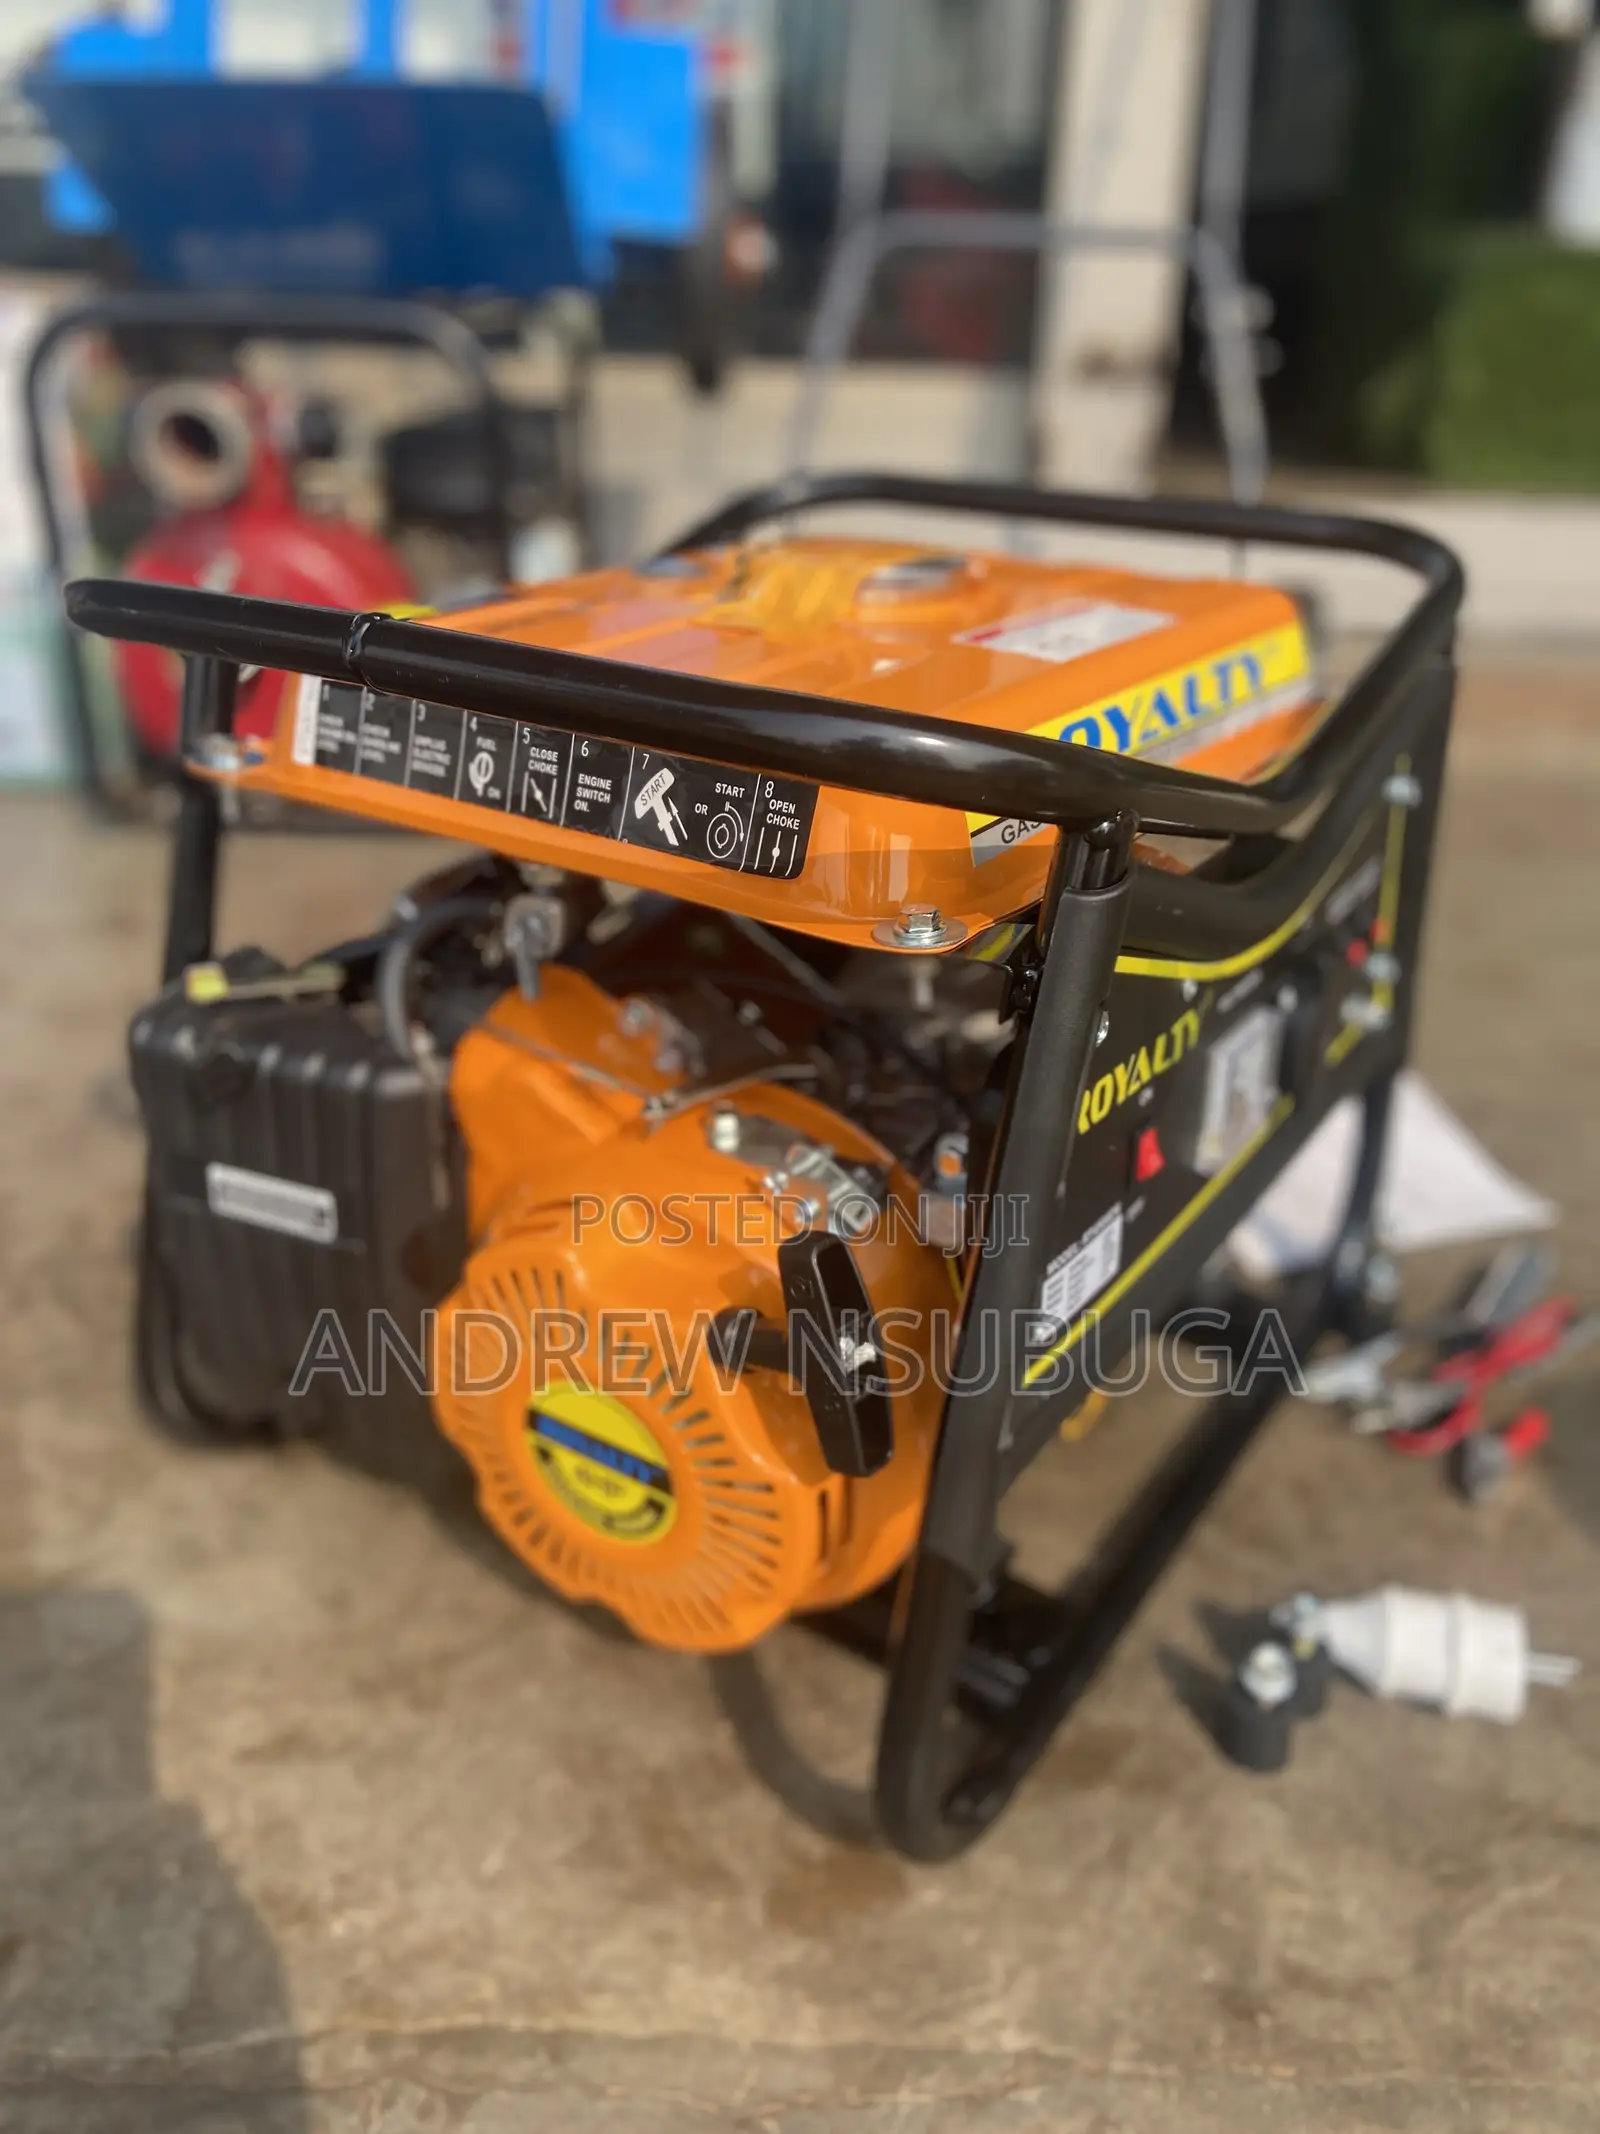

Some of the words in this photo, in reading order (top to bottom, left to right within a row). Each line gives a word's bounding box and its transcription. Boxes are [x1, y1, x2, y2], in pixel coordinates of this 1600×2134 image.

[417, 703, 426, 722] 3
[469, 716, 478, 732] 4
[522, 727, 531, 744] 5
[476, 736, 497, 752] FUEL
[581, 741, 589, 757] 6
[530, 747, 559, 762] CLOSE
[642, 753, 650, 770] 7
[528, 760, 558, 775] CHOKE
[578, 773, 612, 790] ENGINE
[640, 772, 666, 806] START
[764, 781, 774, 798] 8
[576, 786, 611, 803] SWITCH
[715, 782, 746, 798] START
[574, 800, 590, 812] ON.
[694, 802, 708, 815] OR
[769, 799, 796, 814] OPEN
[766, 813, 800, 831] CHOKE
